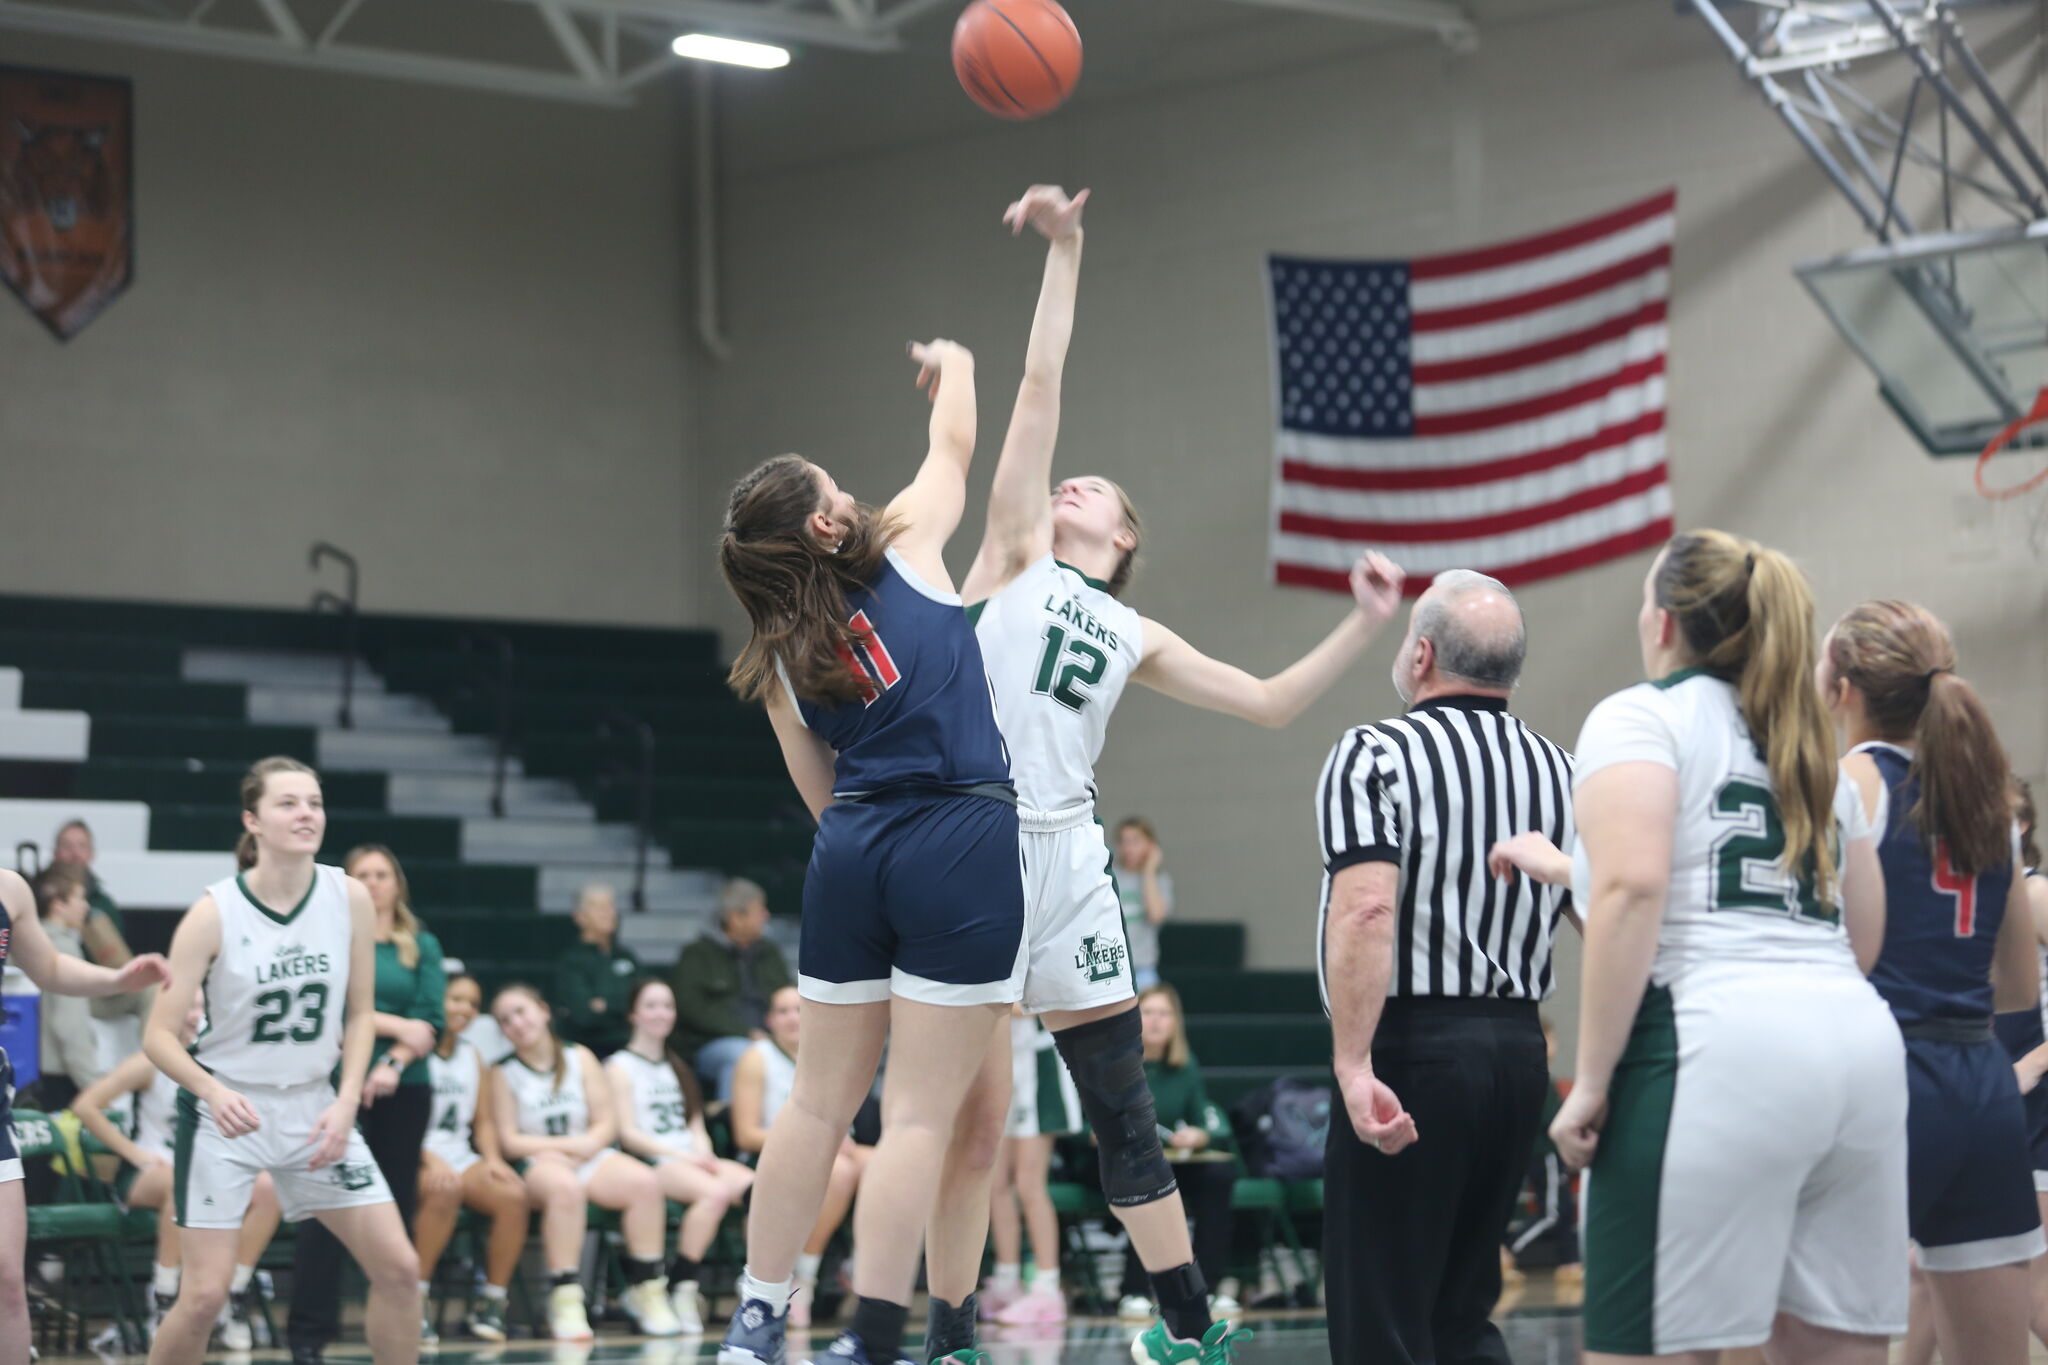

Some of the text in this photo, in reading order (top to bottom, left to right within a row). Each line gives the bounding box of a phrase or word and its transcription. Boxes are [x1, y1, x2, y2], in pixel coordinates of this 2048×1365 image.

[1044, 593, 1118, 651] LAKERS
[1029, 620, 1111, 714] 12
[255, 953, 330, 984] LAKERS
[1074, 944, 1125, 969] LAKERS
[248, 981, 329, 1044] 23
